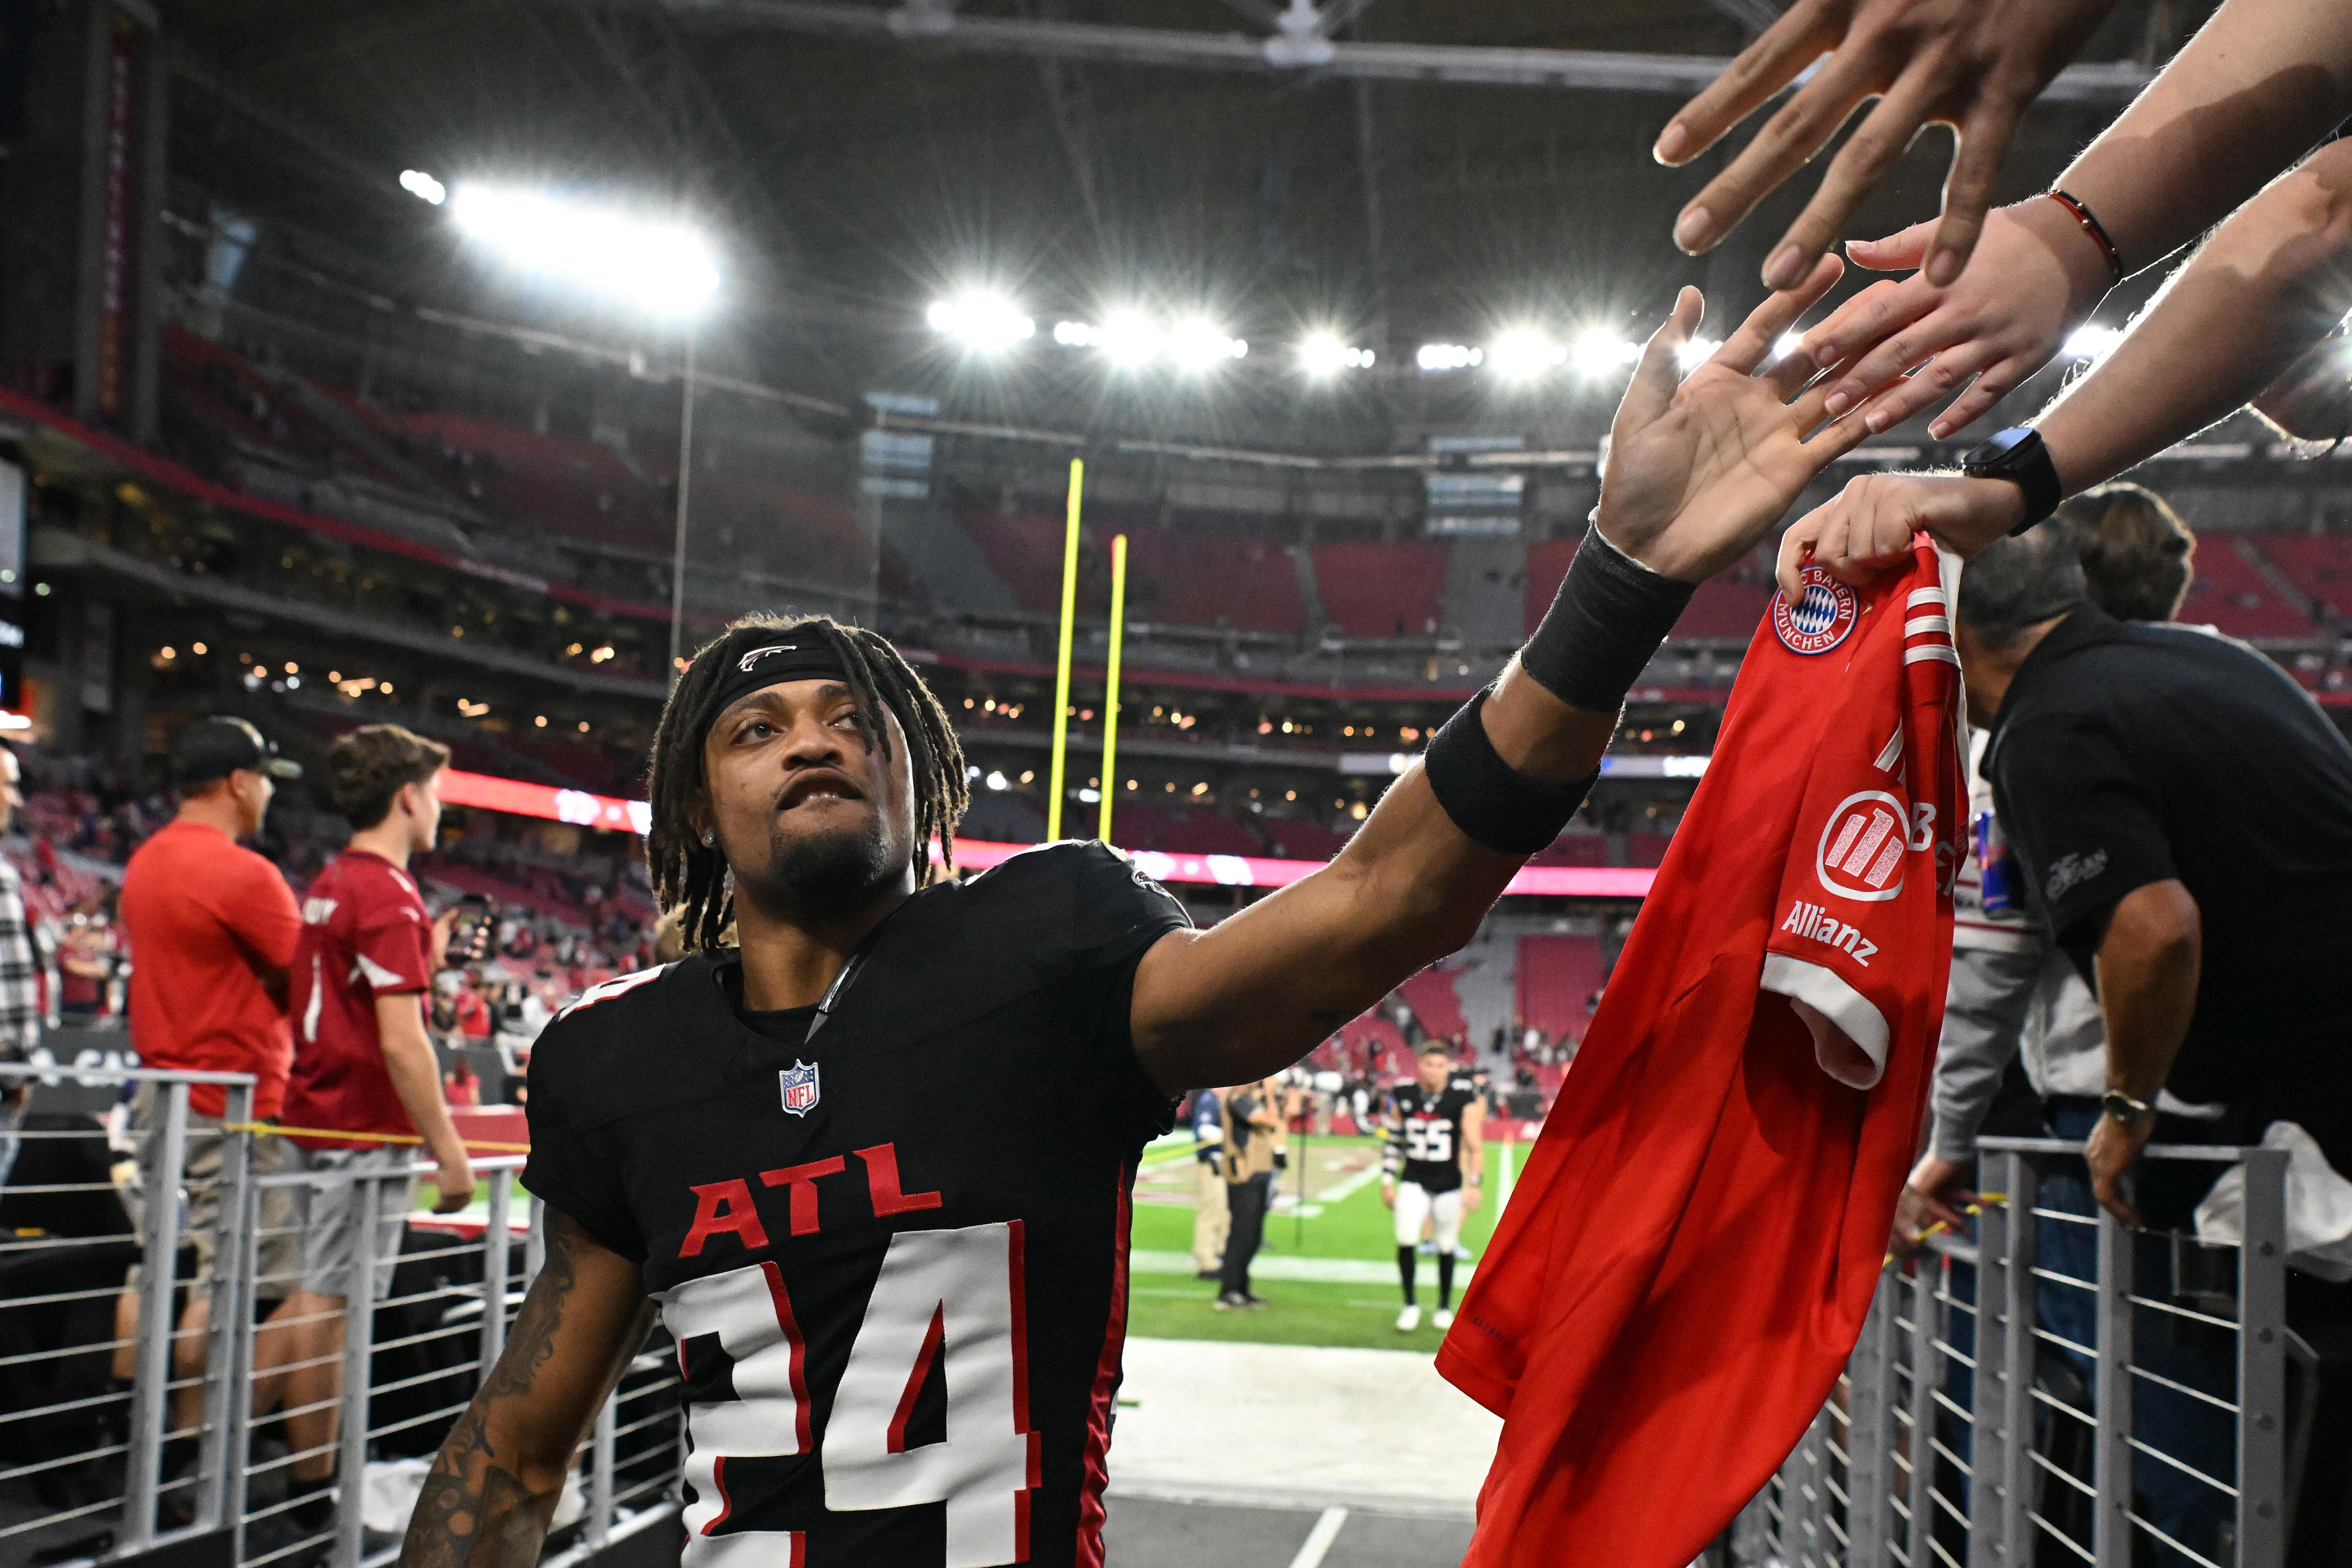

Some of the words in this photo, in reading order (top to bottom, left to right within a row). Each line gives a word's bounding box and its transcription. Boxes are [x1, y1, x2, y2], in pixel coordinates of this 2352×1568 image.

[1813, 570, 1853, 620] BAYERN
[1780, 900, 1879, 968] Allianz
[787, 1085, 814, 1107] NFL
[1405, 1118, 1454, 1161] 55
[678, 1142, 943, 1258] ATL
[648, 1218, 1043, 1568] 24
